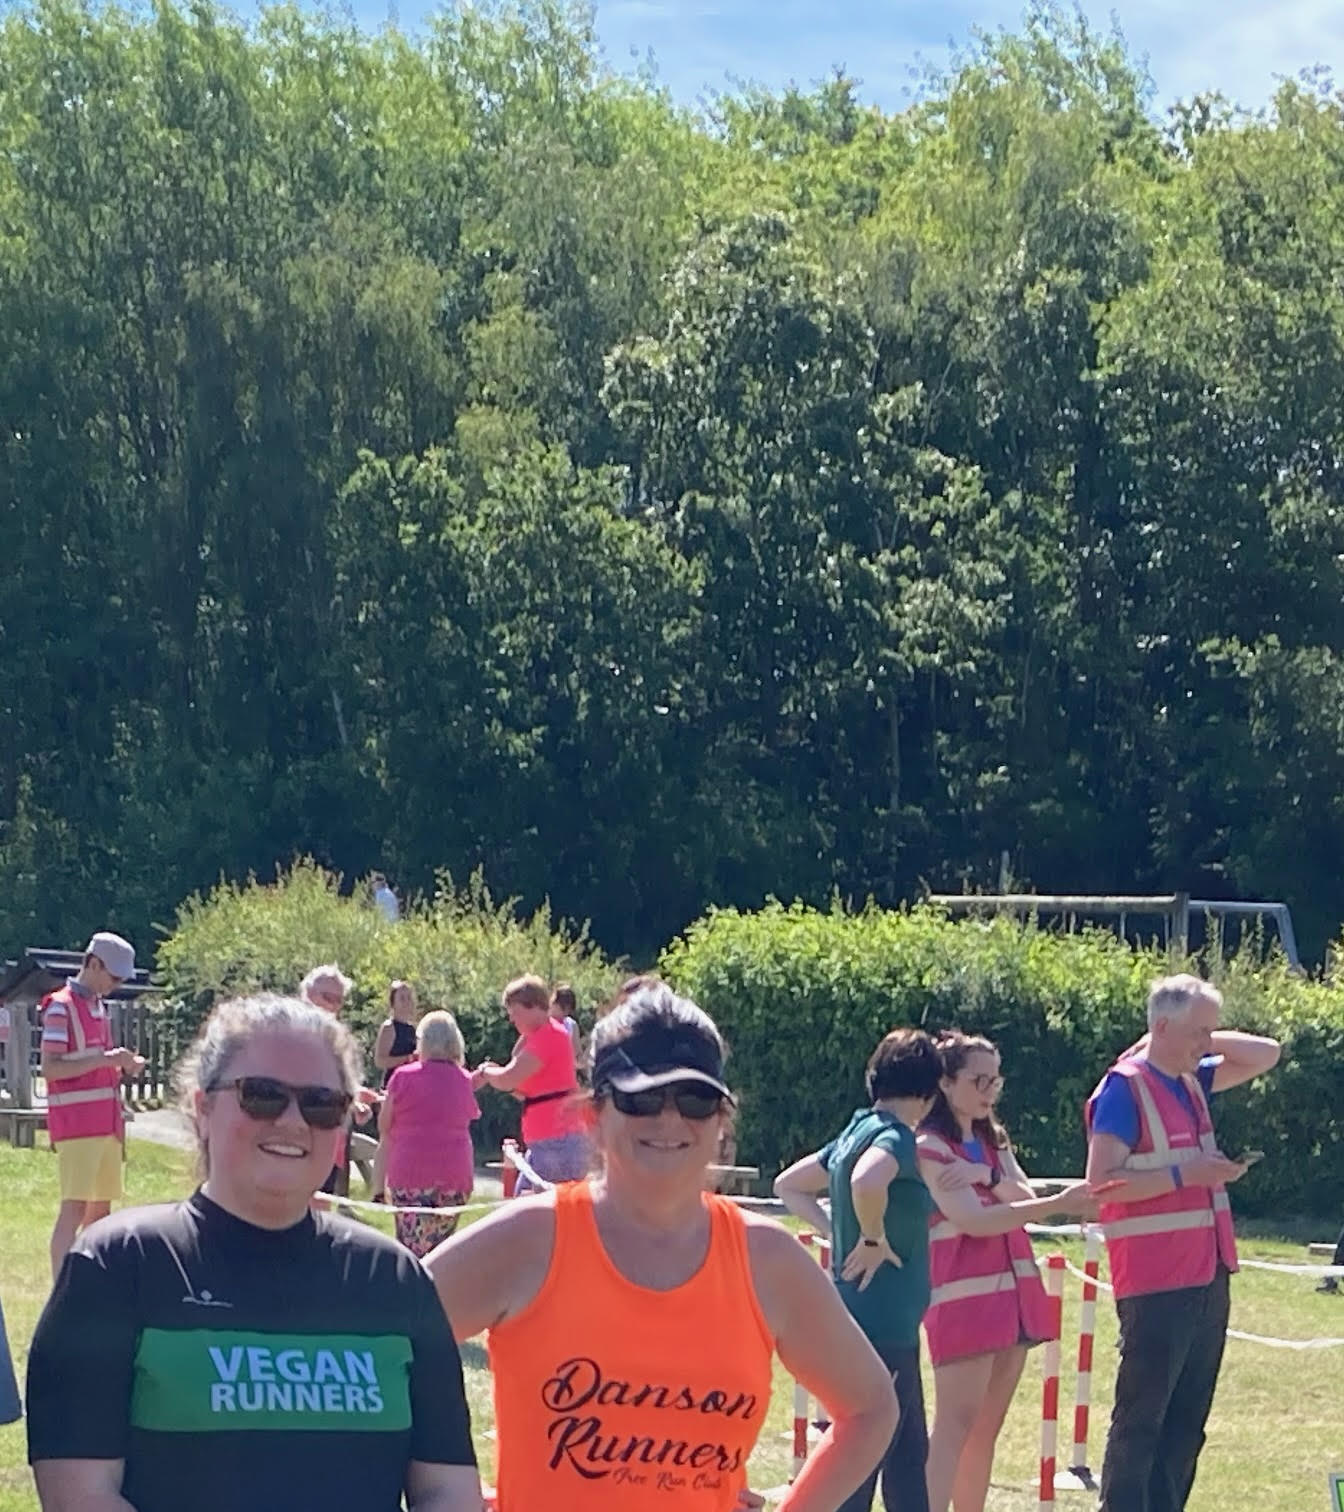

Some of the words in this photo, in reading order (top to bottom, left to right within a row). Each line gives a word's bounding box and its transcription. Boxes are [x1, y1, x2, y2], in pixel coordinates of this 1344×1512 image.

[208, 1346, 378, 1384] VEGAN
[541, 1357, 758, 1420] Danson
[210, 1382, 385, 1413] RUNNERS
[547, 1415, 742, 1480] Runners
